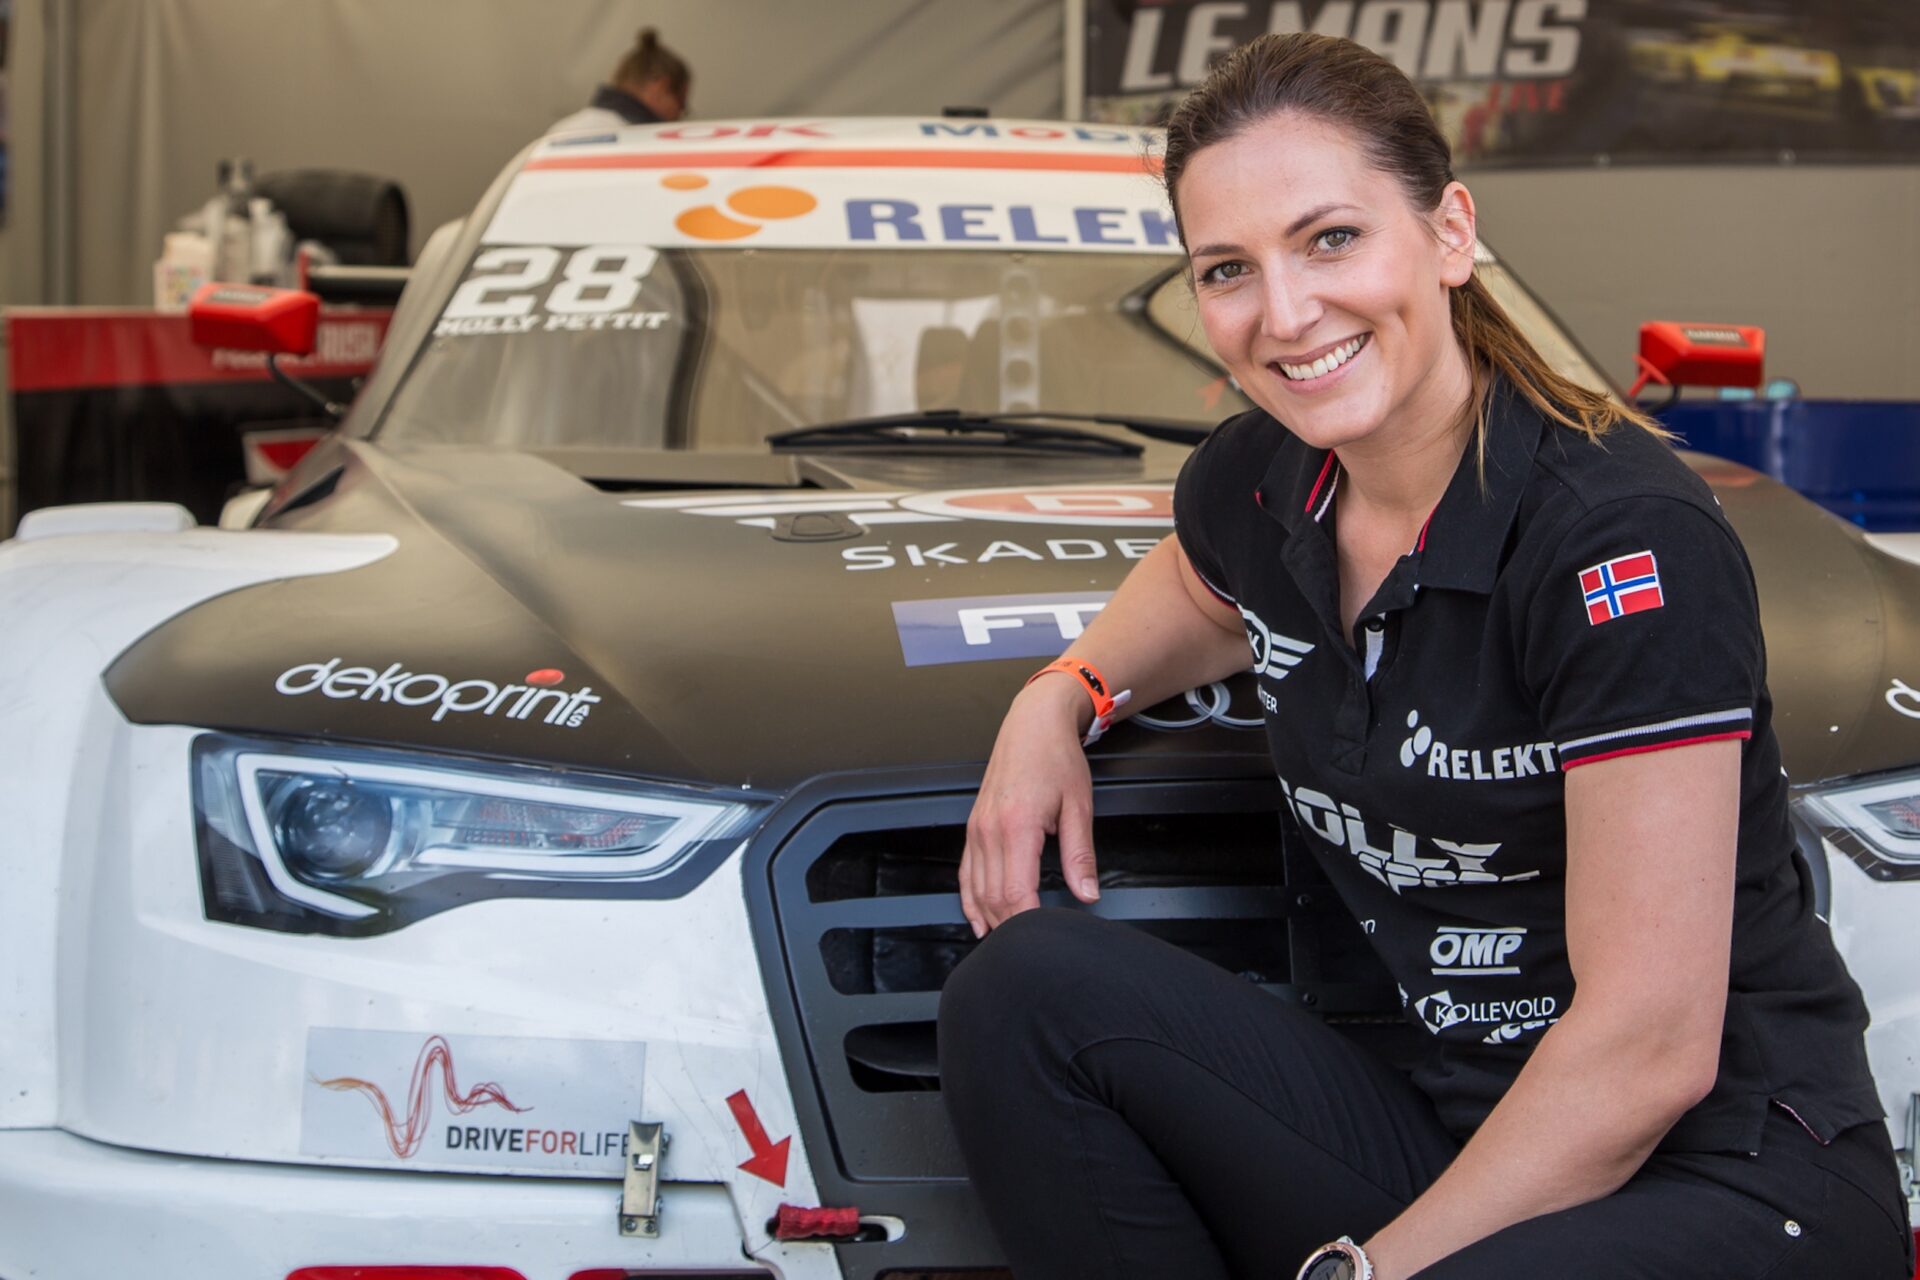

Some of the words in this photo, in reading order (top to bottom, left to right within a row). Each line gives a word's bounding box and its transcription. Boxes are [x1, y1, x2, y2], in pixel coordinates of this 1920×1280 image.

[1122, 3, 1247, 89] LE
[443, 245, 659, 319] 28
[434, 315, 541, 337] MOLLY
[543, 311, 672, 332] PETTIT
[841, 538, 1161, 571] SKADE
[275, 657, 602, 726] dekoprint
[1427, 740, 1557, 781] RELEKT
[1279, 774, 1503, 873] OLLY
[1429, 933, 1523, 967] OMP
[1434, 996, 1556, 1024] KOLLEVOLD
